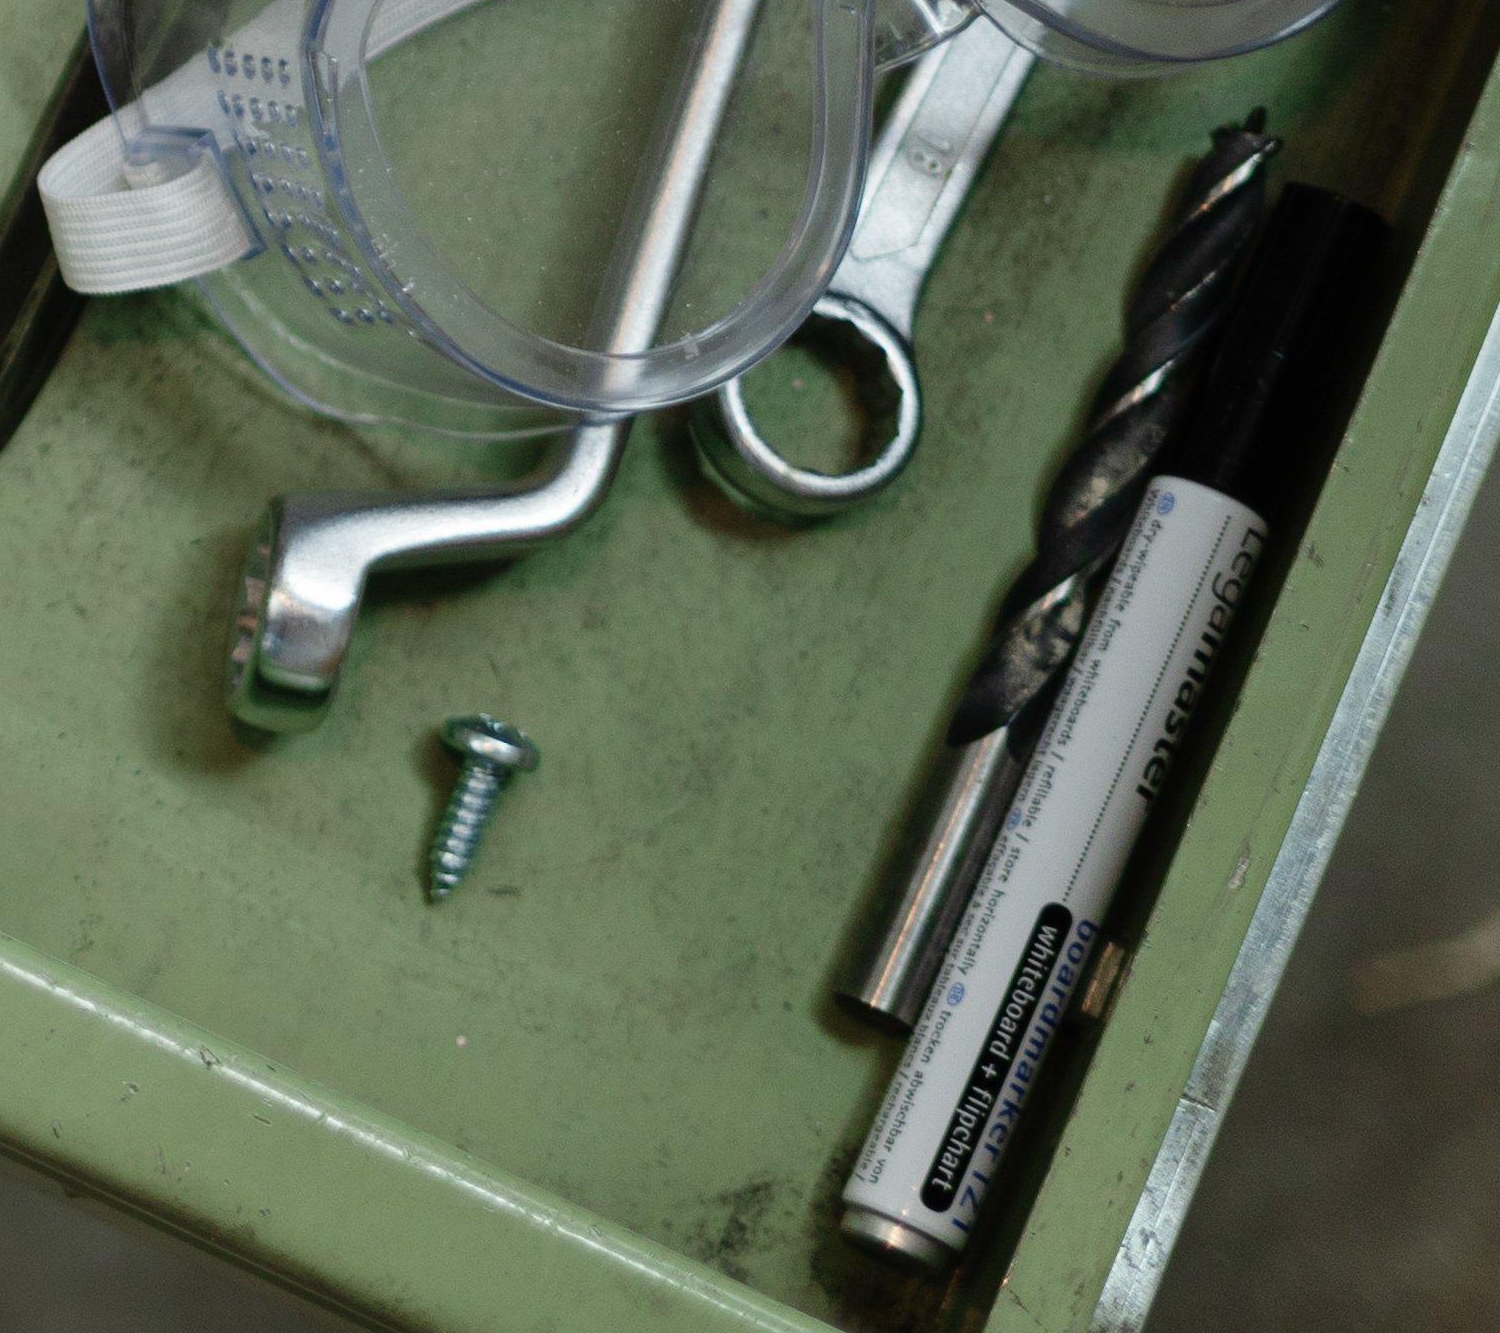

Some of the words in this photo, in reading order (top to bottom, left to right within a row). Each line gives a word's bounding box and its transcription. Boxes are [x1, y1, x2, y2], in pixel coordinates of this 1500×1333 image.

[1111, 517, 1164, 613] dry-wipeable
[1096, 617, 1122, 653] from
[1056, 657, 1104, 747] whiteboards
[1021, 764, 1058, 829] refillable
[997, 845, 1022, 884] store
[955, 886, 1005, 976] horizontally
[987, 924, 1059, 1060] whiteboard
[919, 1008, 952, 1065] trocken
[881, 1069, 927, 1153] abwischbar
[930, 1083, 992, 1191] flipchart
[867, 1156, 887, 1184] von
